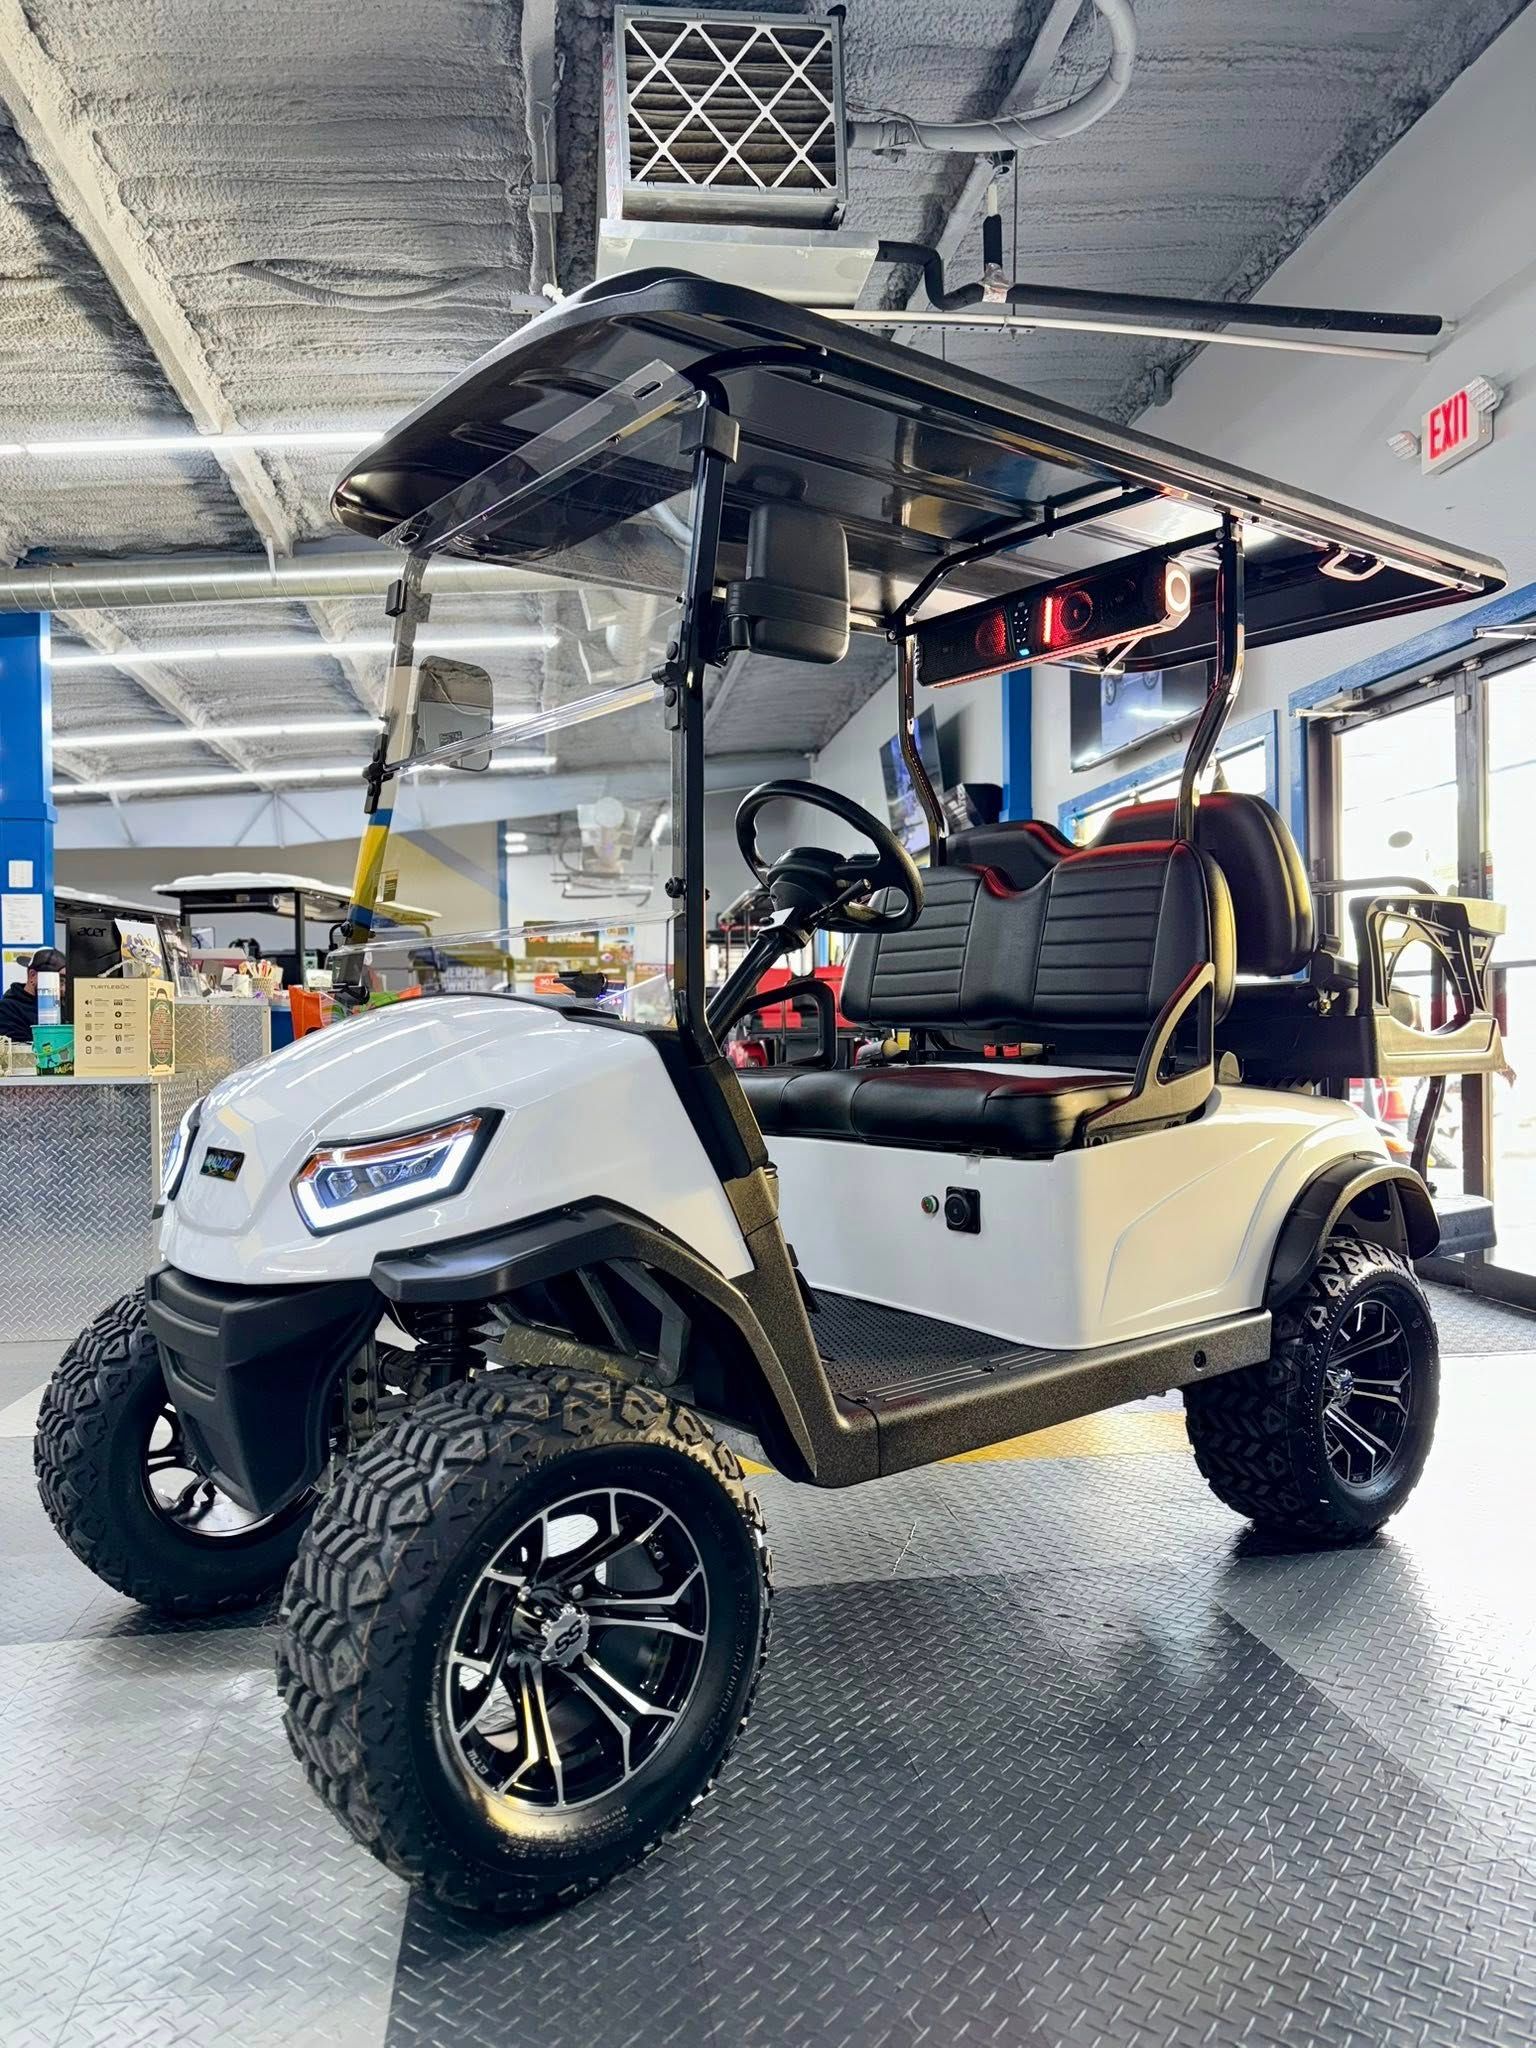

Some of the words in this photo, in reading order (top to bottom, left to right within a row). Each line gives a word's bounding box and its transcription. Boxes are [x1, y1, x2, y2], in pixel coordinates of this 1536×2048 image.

[1430, 391, 1468, 459] EXIT
[77, 926, 107, 938] acer
[90, 983, 130, 991] TURTLEBOX
